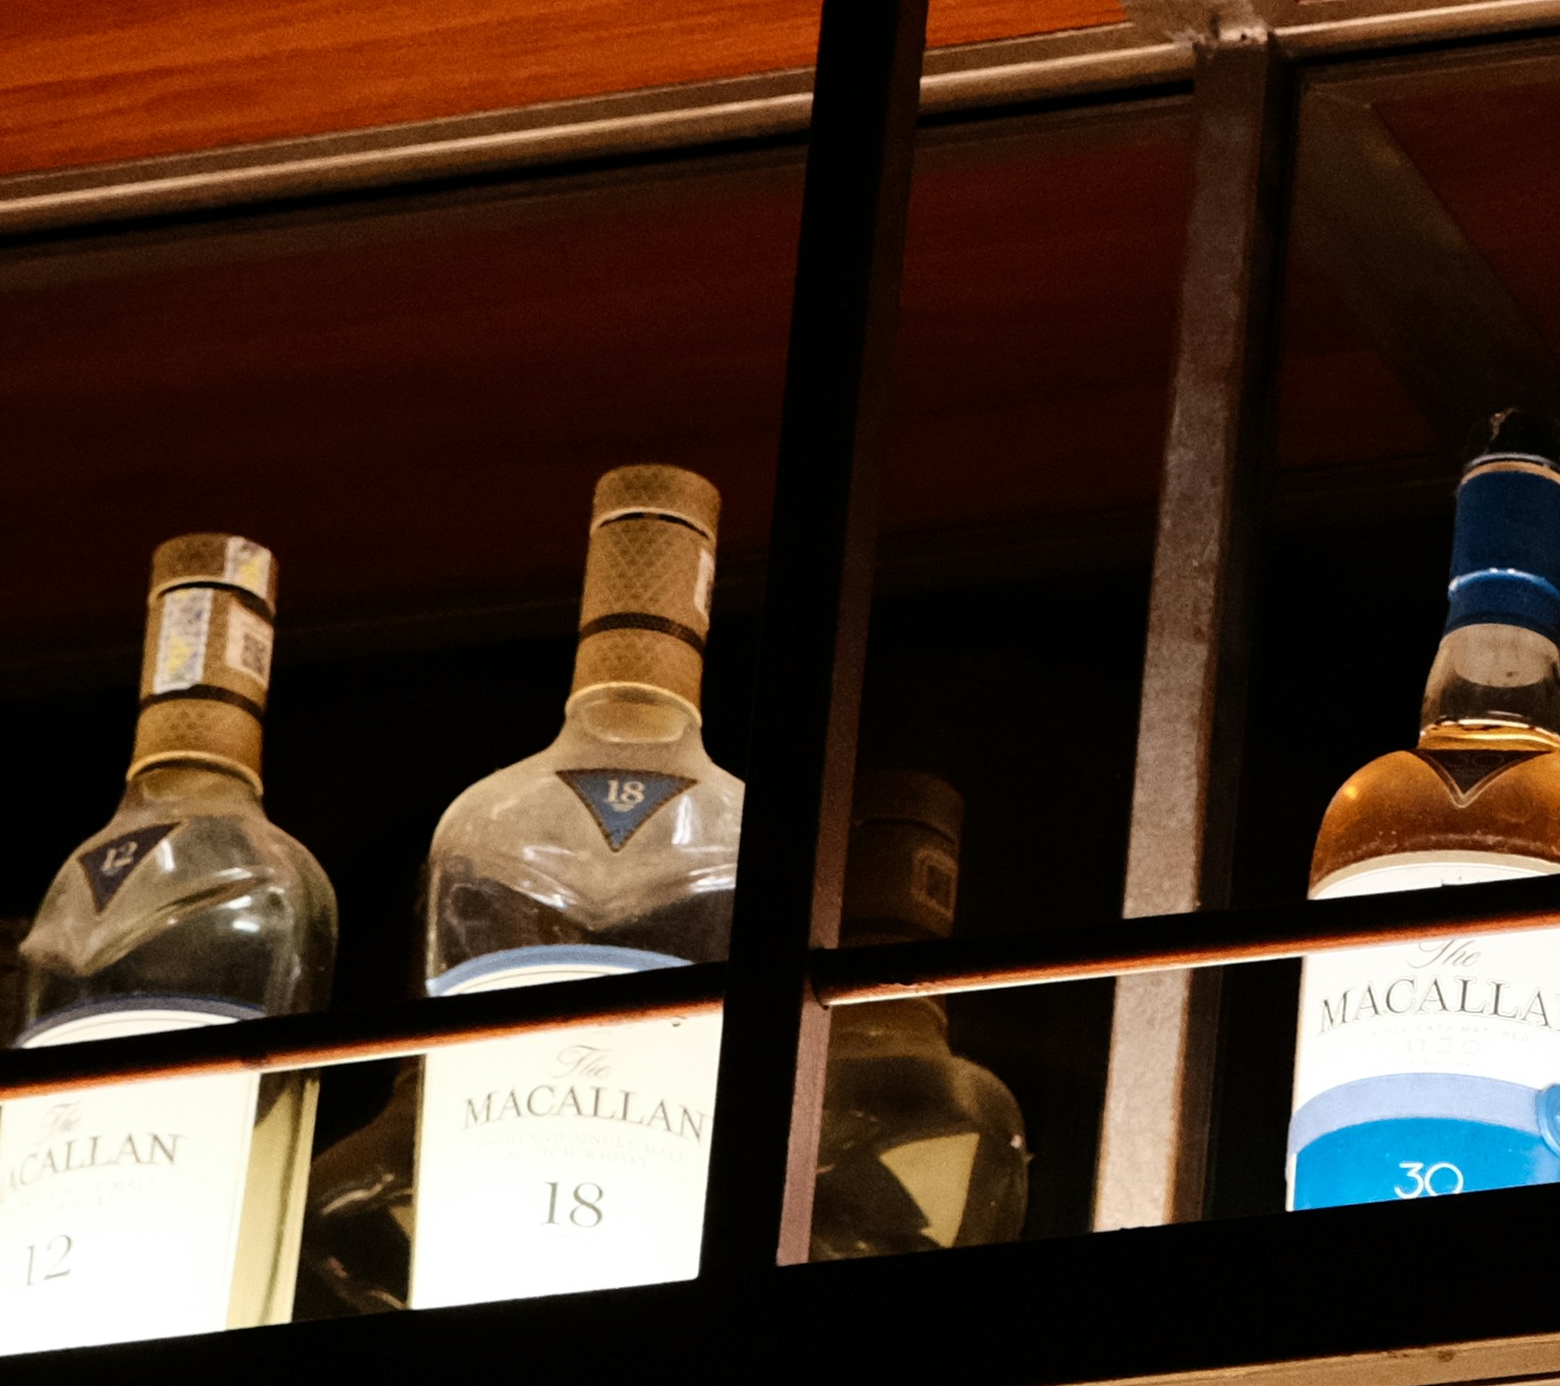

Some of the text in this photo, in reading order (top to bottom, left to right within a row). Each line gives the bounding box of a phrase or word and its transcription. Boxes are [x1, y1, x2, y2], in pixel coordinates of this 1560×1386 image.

[606, 778, 645, 804] 18
[102, 840, 138, 872] 12
[1406, 938, 1482, 969] The
[550, 1044, 614, 1080] The
[461, 1084, 708, 1144] MACALLAN
[1393, 1160, 1465, 1199] 30
[541, 1180, 606, 1228] 18
[25, 1233, 74, 1287] 12
